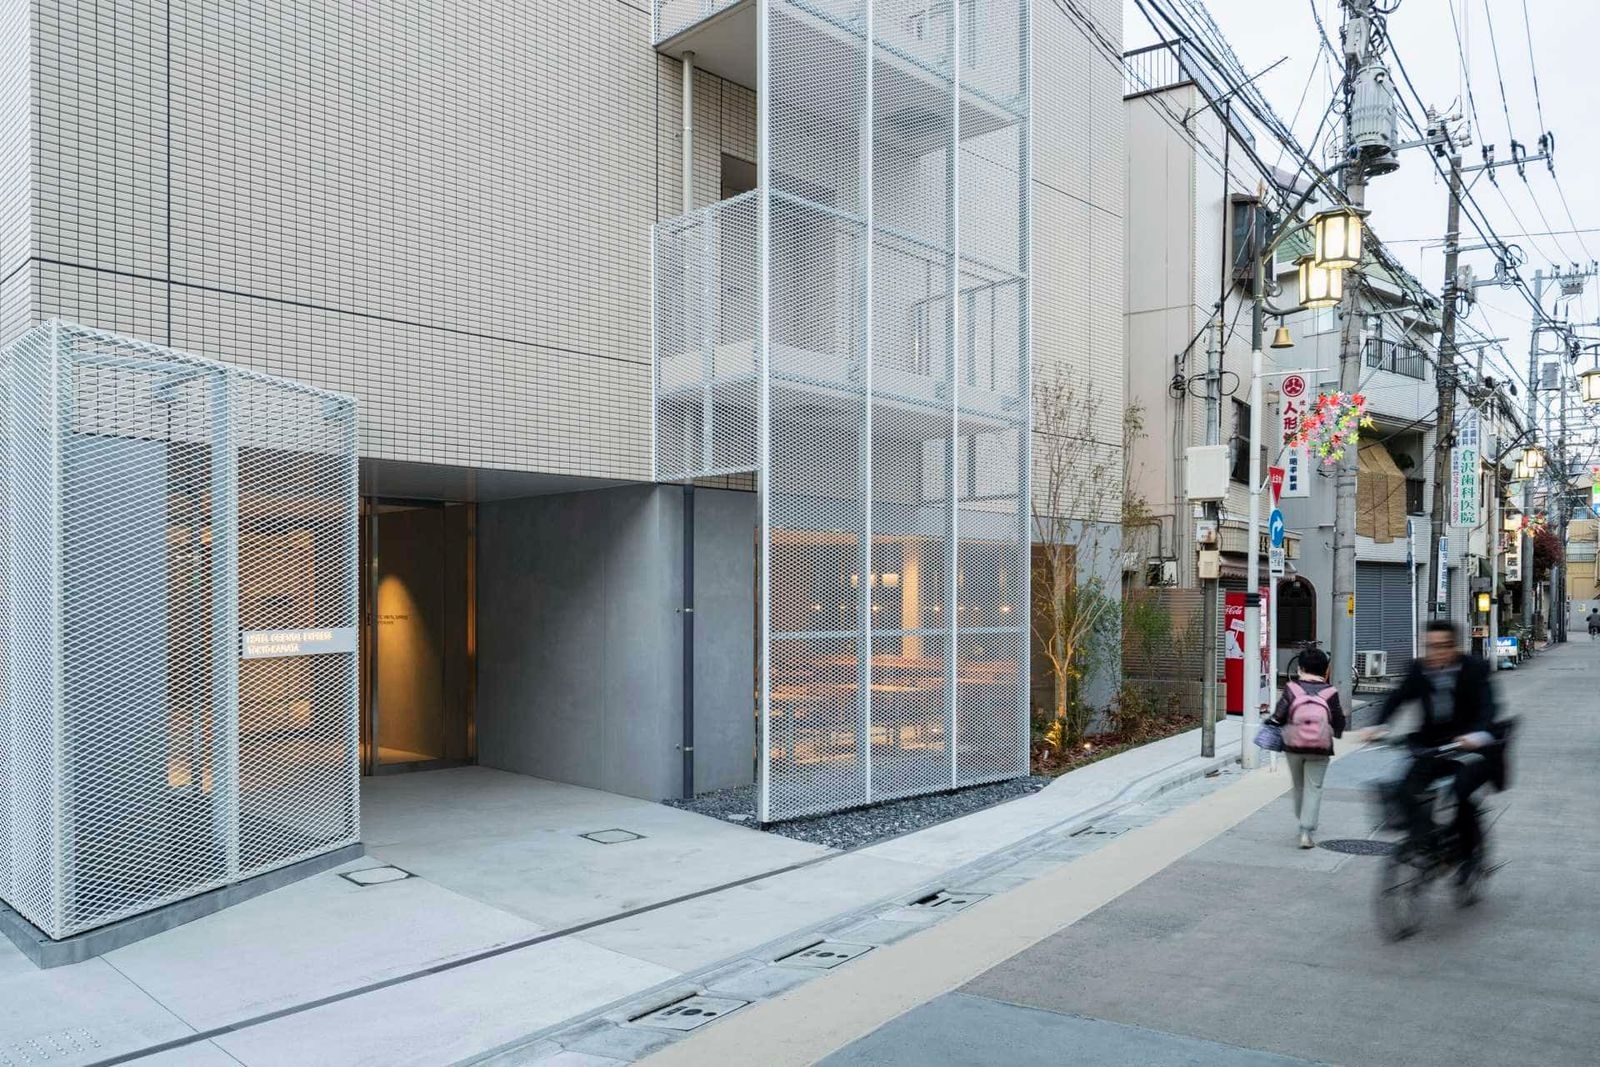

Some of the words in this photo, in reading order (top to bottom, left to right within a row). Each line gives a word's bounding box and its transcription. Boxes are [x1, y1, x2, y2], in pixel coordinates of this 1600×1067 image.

[1460, 449, 1475, 524] 倉沢歯科医院
[246, 633, 269, 643] HOTEL
